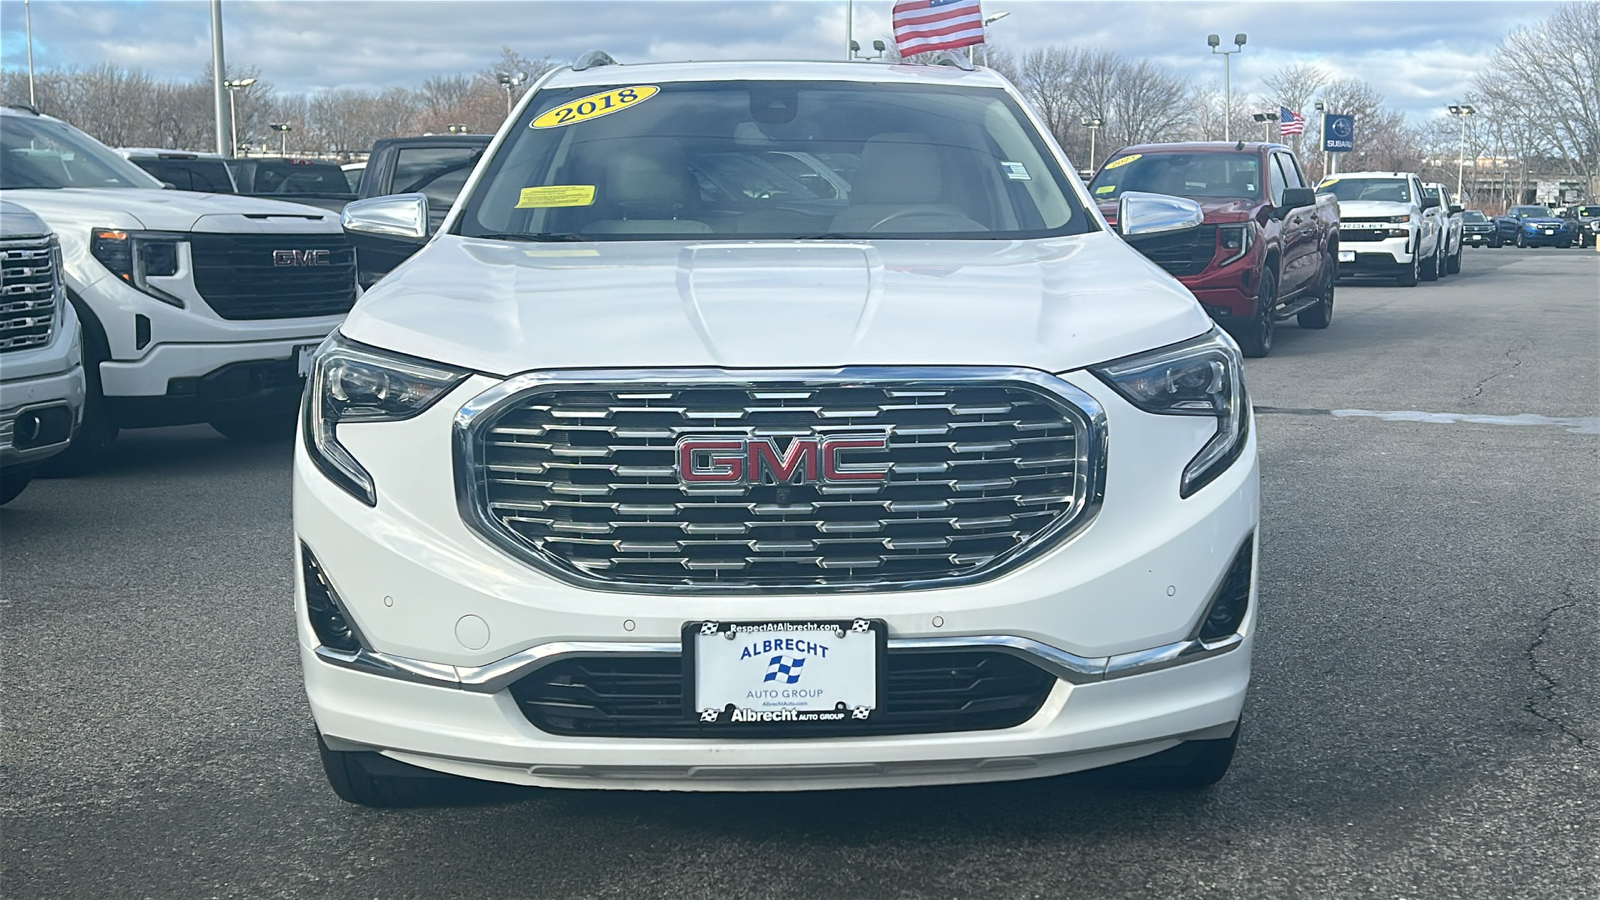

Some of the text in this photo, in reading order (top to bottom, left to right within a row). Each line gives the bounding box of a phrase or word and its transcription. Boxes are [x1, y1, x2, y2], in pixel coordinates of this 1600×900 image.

[555, 88, 639, 124] 2018
[1326, 139, 1353, 149] SUBARU
[273, 249, 330, 267] GMC
[675, 434, 891, 487] GMC
[730, 621, 840, 633] RespectAtAlbrecht.com
[740, 638, 829, 660] ALBRECHT
[746, 689, 824, 699] AUTO GROUP
[731, 708, 845, 722] Albrecht AUTO GROUP
